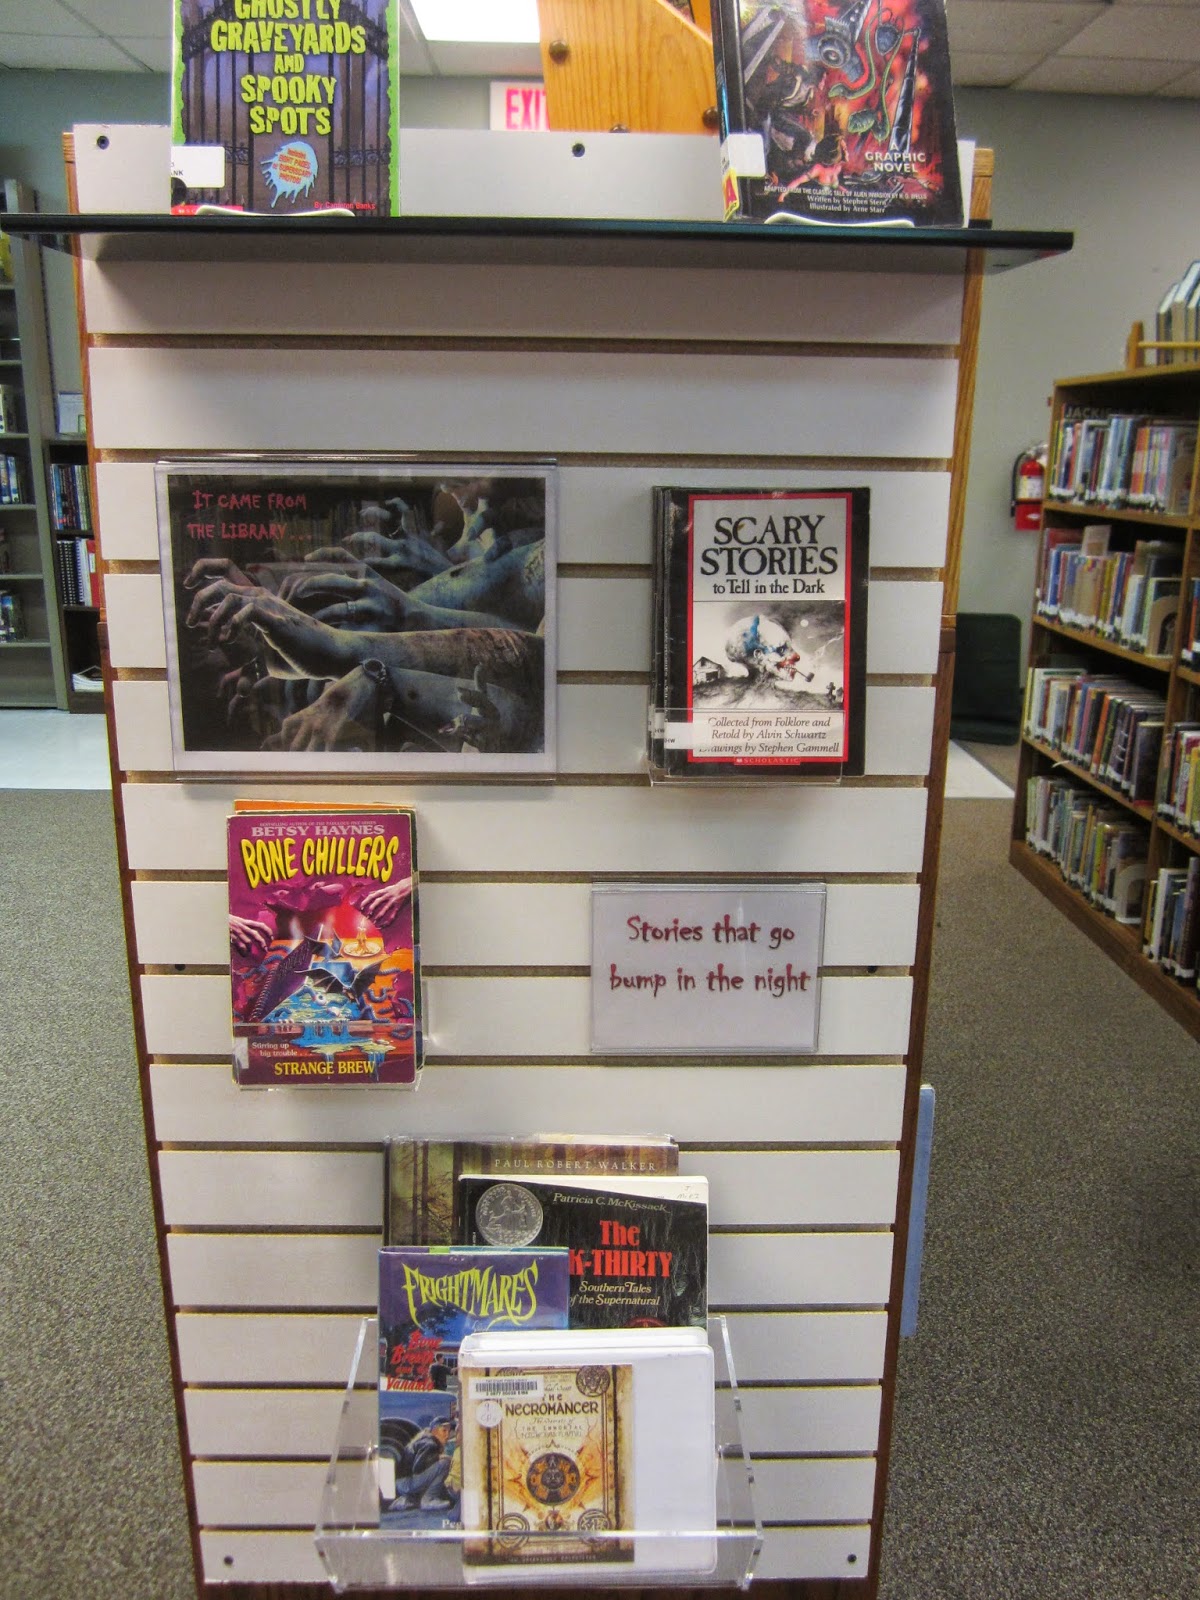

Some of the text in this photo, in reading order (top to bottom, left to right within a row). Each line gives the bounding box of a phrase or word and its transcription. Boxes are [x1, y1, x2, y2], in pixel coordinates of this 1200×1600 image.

[234, 0, 341, 20] GHOSTLY
[210, 20, 367, 56] GRAVEYARDS
[274, 54, 305, 74] AND
[240, 75, 338, 105] SPOOKY
[250, 106, 332, 135] SPOTS
[889, 142, 900, 151] A
[864, 151, 927, 163] GRAPHIC
[873, 162, 919, 173] NOVEL
[313, 201, 323, 210] By
[807, 195, 832, 203] Written
[833, 197, 841, 205] by
[842, 198, 868, 206] Stephen
[809, 203, 842, 211] Illustrated
[843, 205, 851, 213] by
[193, 489, 307, 511] IT CAME FROM
[187, 522, 216, 540] THE
[713, 515, 825, 545] SCARY
[700, 547, 838, 576] STORIES
[713, 579, 826, 595] to Tell in the Dark
[707, 716, 831, 729] Collected from Folklore and
[711, 729, 827, 740] Retold by Alvin Schwartz
[699, 742, 840, 754] awings by Stephen Gammell
[251, 825, 385, 837] BETSY HAYNES
[242, 835, 399, 889] BONE CHILLERS
[627, 914, 795, 949] Stories that go
[609, 963, 811, 998] bump in the night
[252, 1042, 290, 1050] Stirring up
[259, 1050, 272, 1058] big
[274, 1060, 375, 1075] STRANGE BREW
[494, 1159, 657, 1171] PAUL ROBERT WALKER
[553, 1192, 594, 1205] Patricia
[595, 1196, 606, 1206] C.
[607, 1197, 672, 1213] McKissack
[600, 1220, 641, 1247] The
[569, 1249, 673, 1278] K-THIRTY
[402, 1259, 539, 1329] FRIGHTMARES
[578, 1280, 652, 1293] Southern Tales
[579, 1294, 595, 1304] the
[595, 1293, 661, 1306] Supernatural
